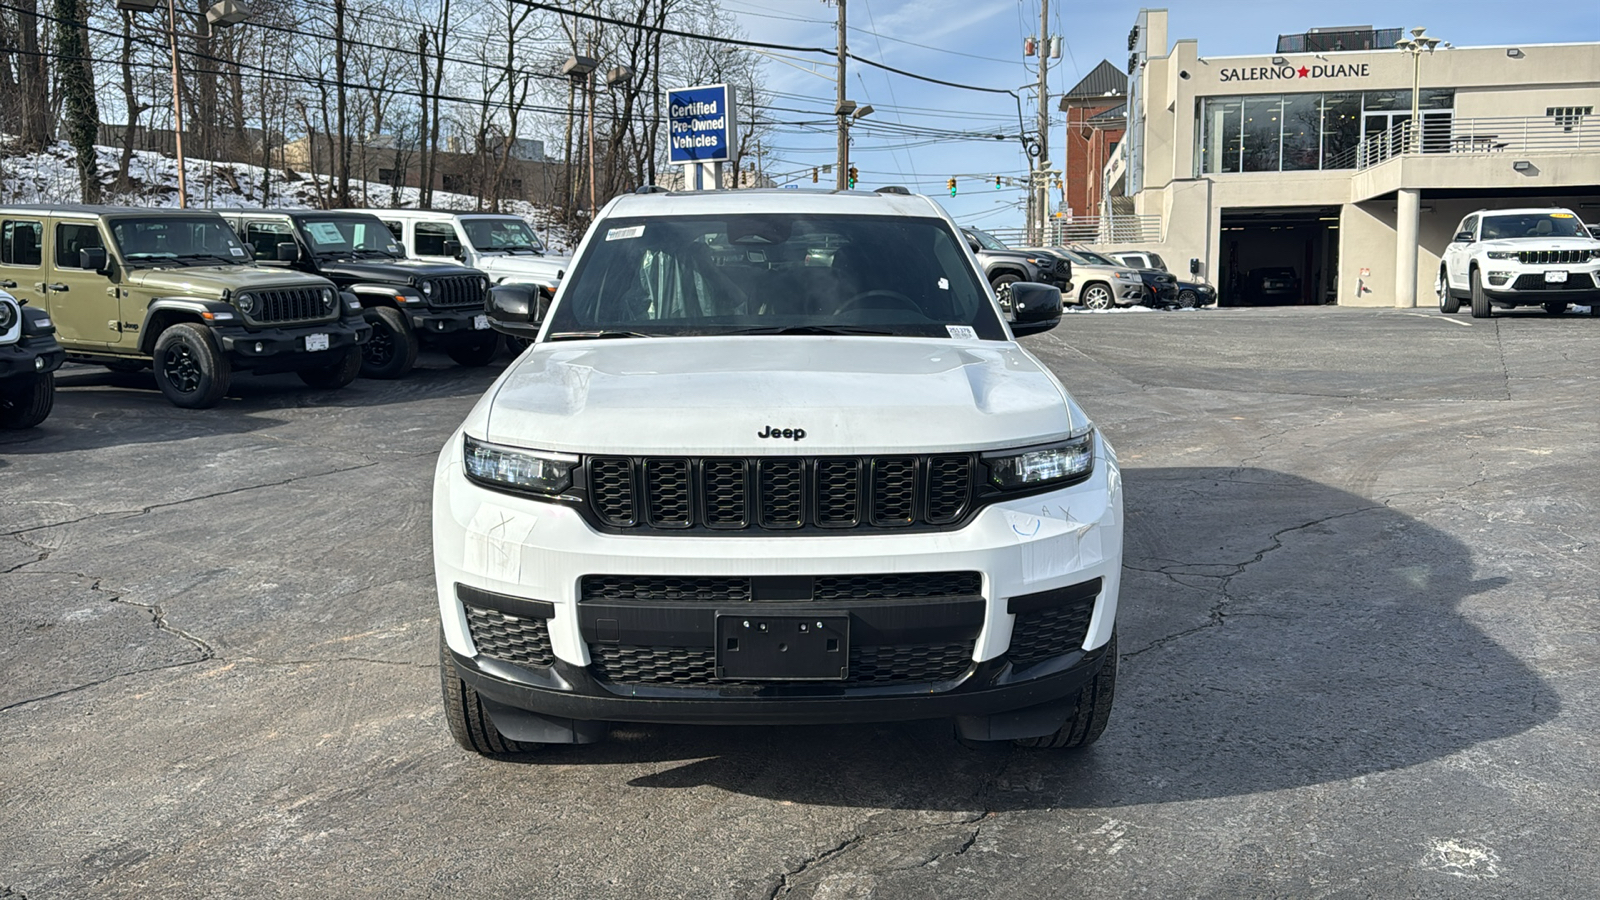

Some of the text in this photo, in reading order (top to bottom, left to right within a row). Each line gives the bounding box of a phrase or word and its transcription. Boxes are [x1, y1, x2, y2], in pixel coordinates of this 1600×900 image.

[1220, 64, 1370, 82] SALERNO DUANE
[671, 100, 717, 117] Certified
[672, 116, 724, 133] Pre-Owned
[673, 134, 718, 149] Vehicles
[757, 425, 806, 441] Jeep
